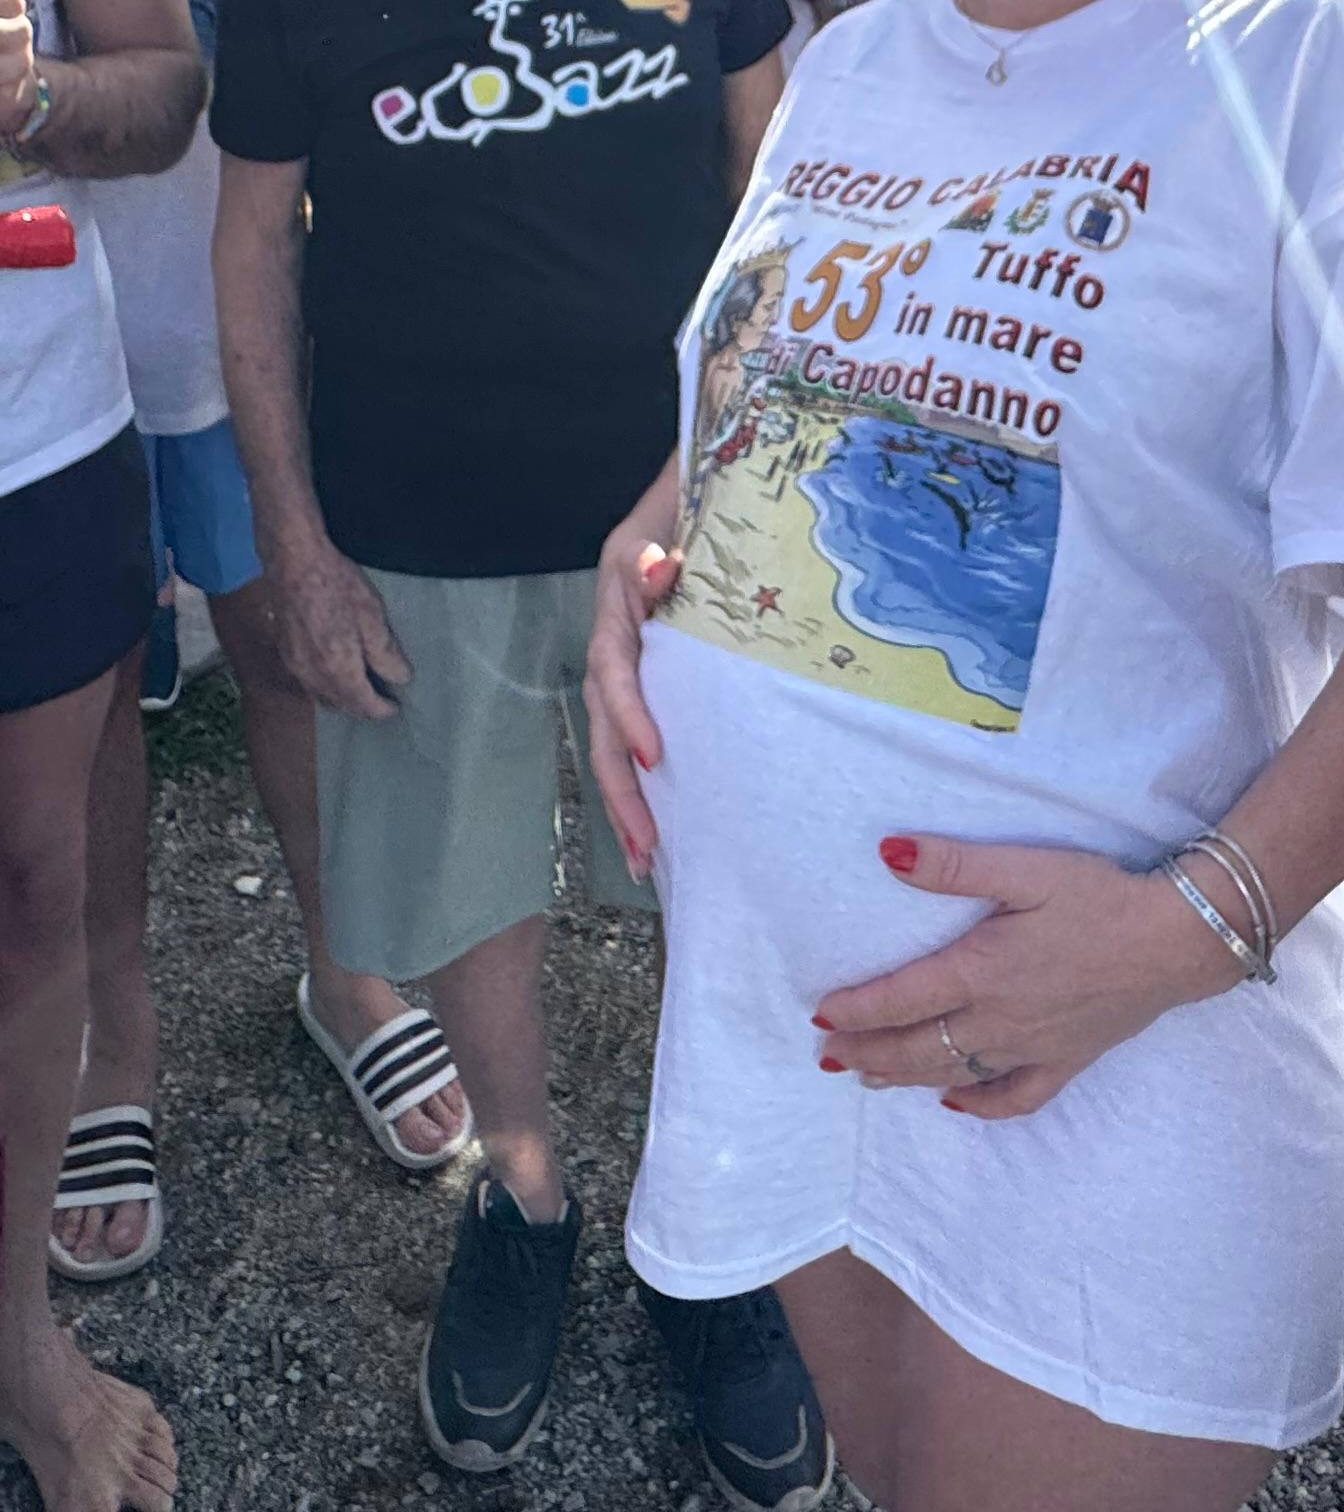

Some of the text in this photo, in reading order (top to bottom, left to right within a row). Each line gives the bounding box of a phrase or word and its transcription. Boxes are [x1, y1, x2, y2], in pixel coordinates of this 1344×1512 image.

[783, 152, 1153, 213] REGGIO CALABRIA
[972, 239, 1107, 311] Tuffo
[894, 291, 1086, 377] in mare
[802, 343, 1063, 439] Capodanno
